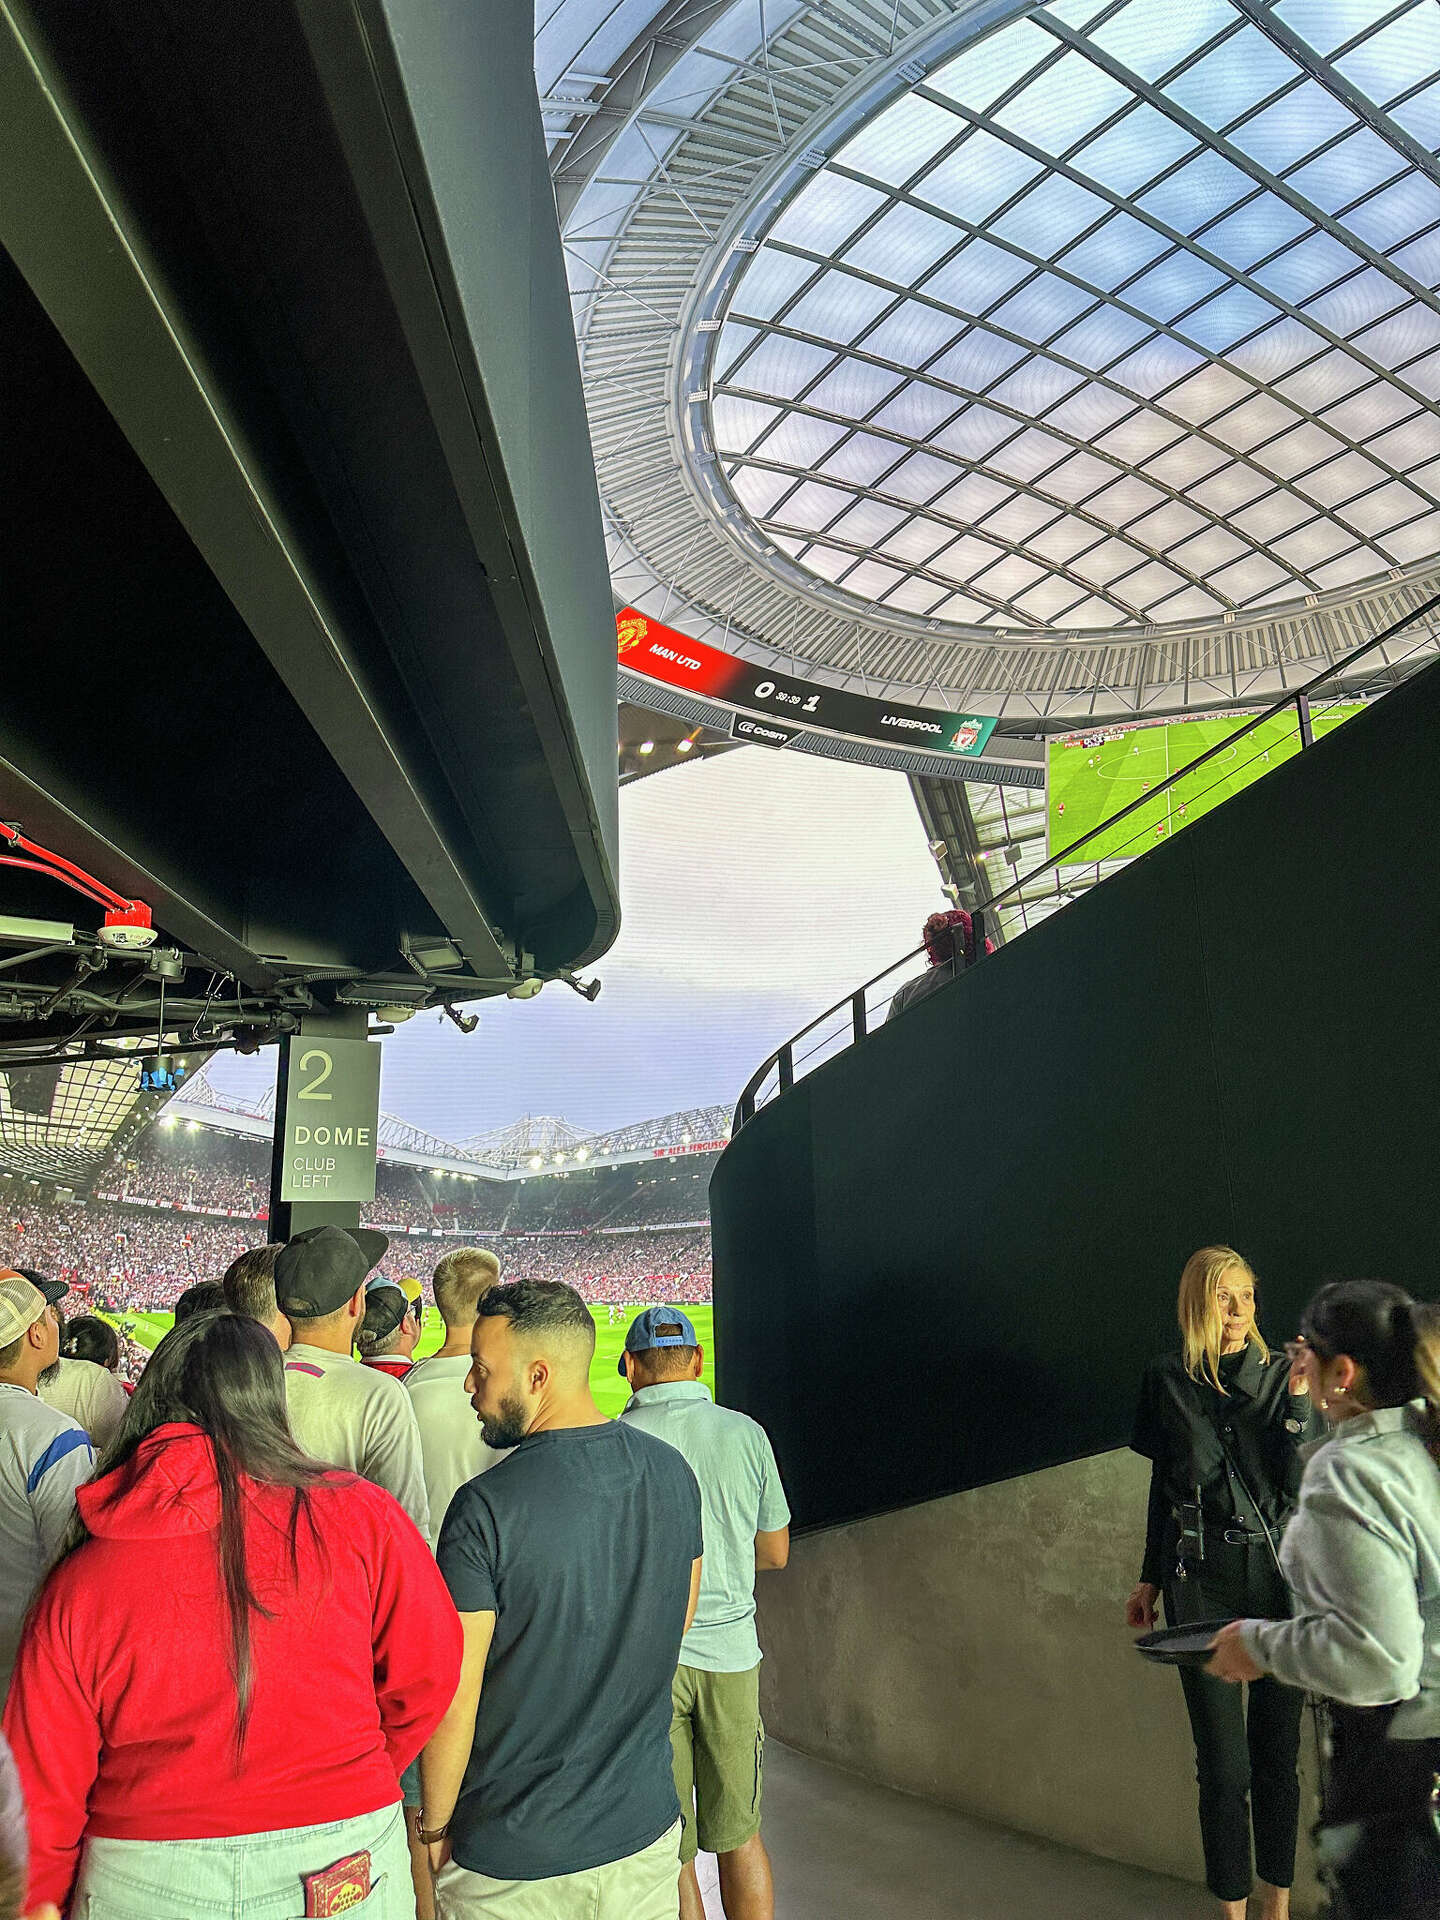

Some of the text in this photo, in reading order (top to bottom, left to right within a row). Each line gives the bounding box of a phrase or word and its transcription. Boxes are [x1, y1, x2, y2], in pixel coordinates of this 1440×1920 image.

[649, 643, 702, 670] MAN UTD
[754, 681, 776, 698] 0
[801, 695, 821, 712] 1
[880, 715, 943, 734] LIVERPOOL
[298, 1049, 333, 1101] 2
[295, 1126, 370, 1146] DOME
[293, 1157, 336, 1171] CLUB
[292, 1175, 333, 1188] LEFT
